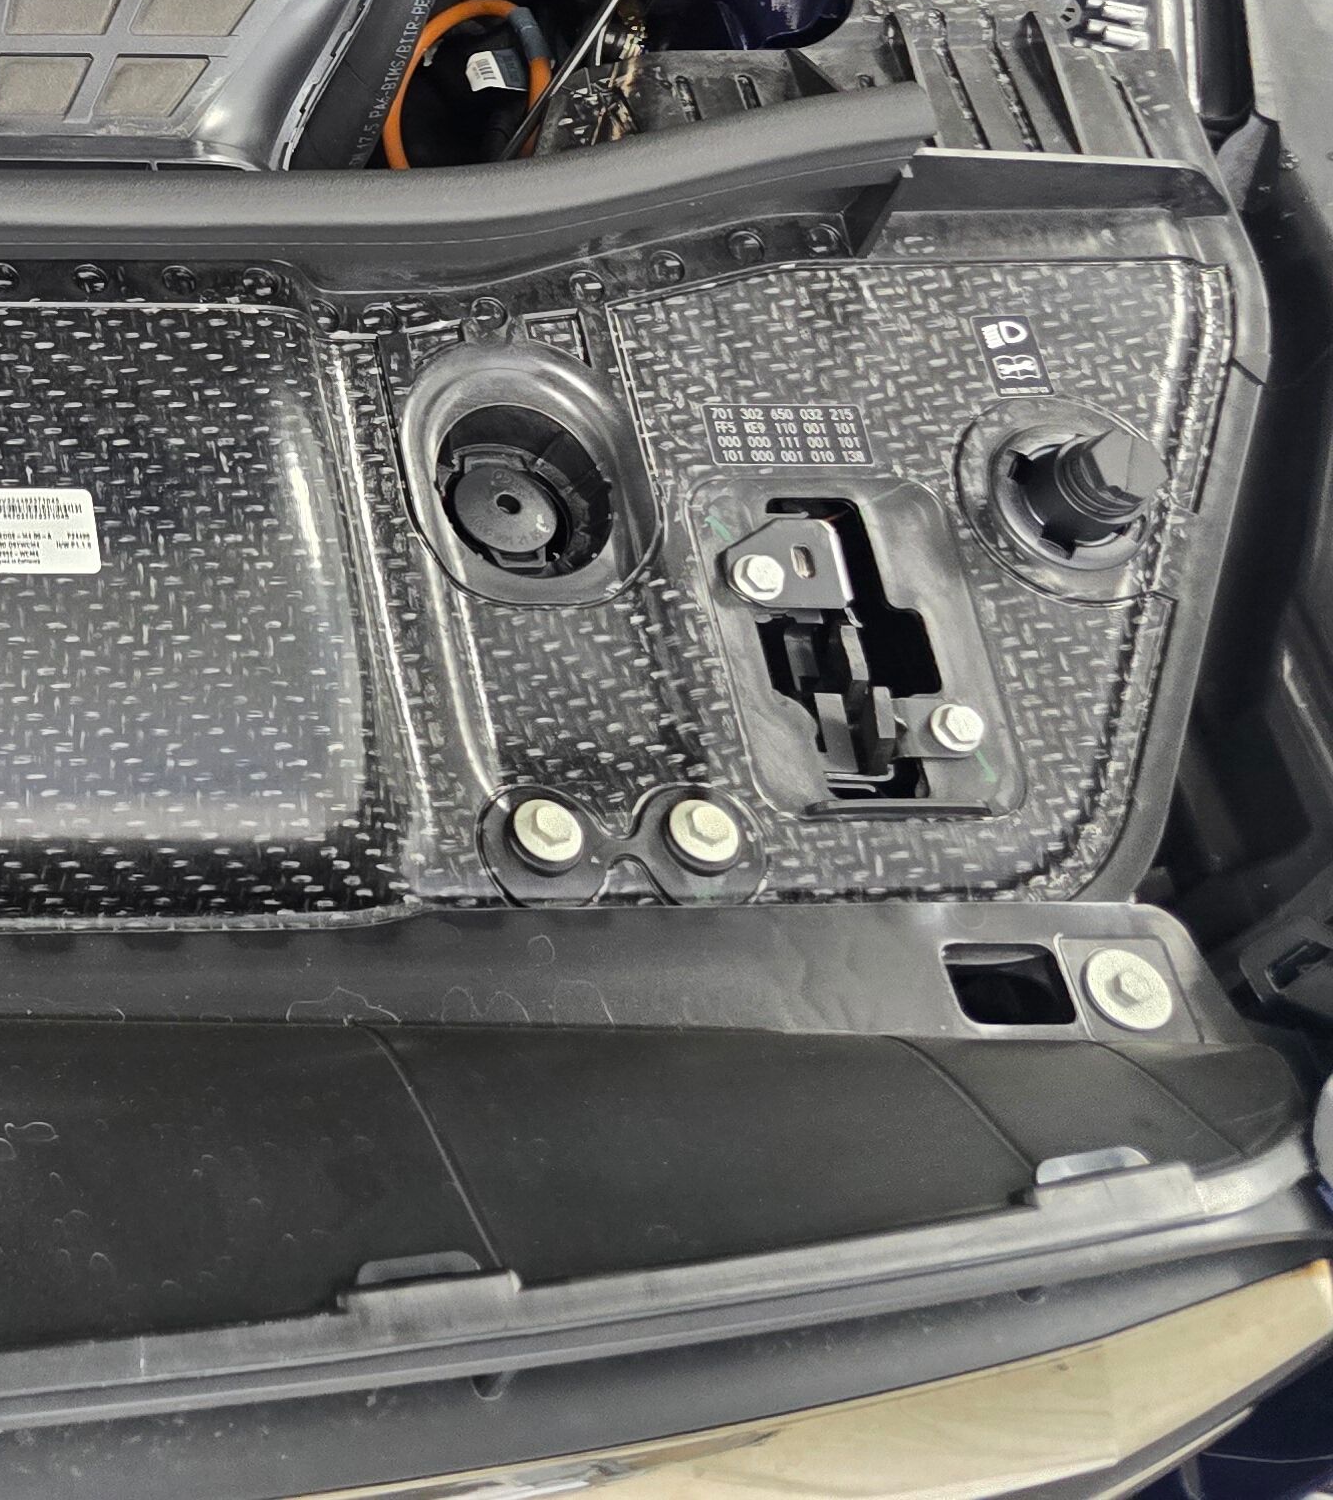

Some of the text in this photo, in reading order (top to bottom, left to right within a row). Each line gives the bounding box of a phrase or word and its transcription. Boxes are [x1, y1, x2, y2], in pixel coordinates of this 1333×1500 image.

[709, 407, 854, 420] 701 302 650 032 215
[774, 422, 797, 434] 110
[803, 422, 827, 434] 001
[833, 423, 858, 435] 101
[717, 435, 862, 449] 000 000 111 001 101
[721, 449, 745, 462] 101
[750, 449, 775, 462] 000
[780, 449, 804, 462] 001
[810, 449, 835, 462] 010
